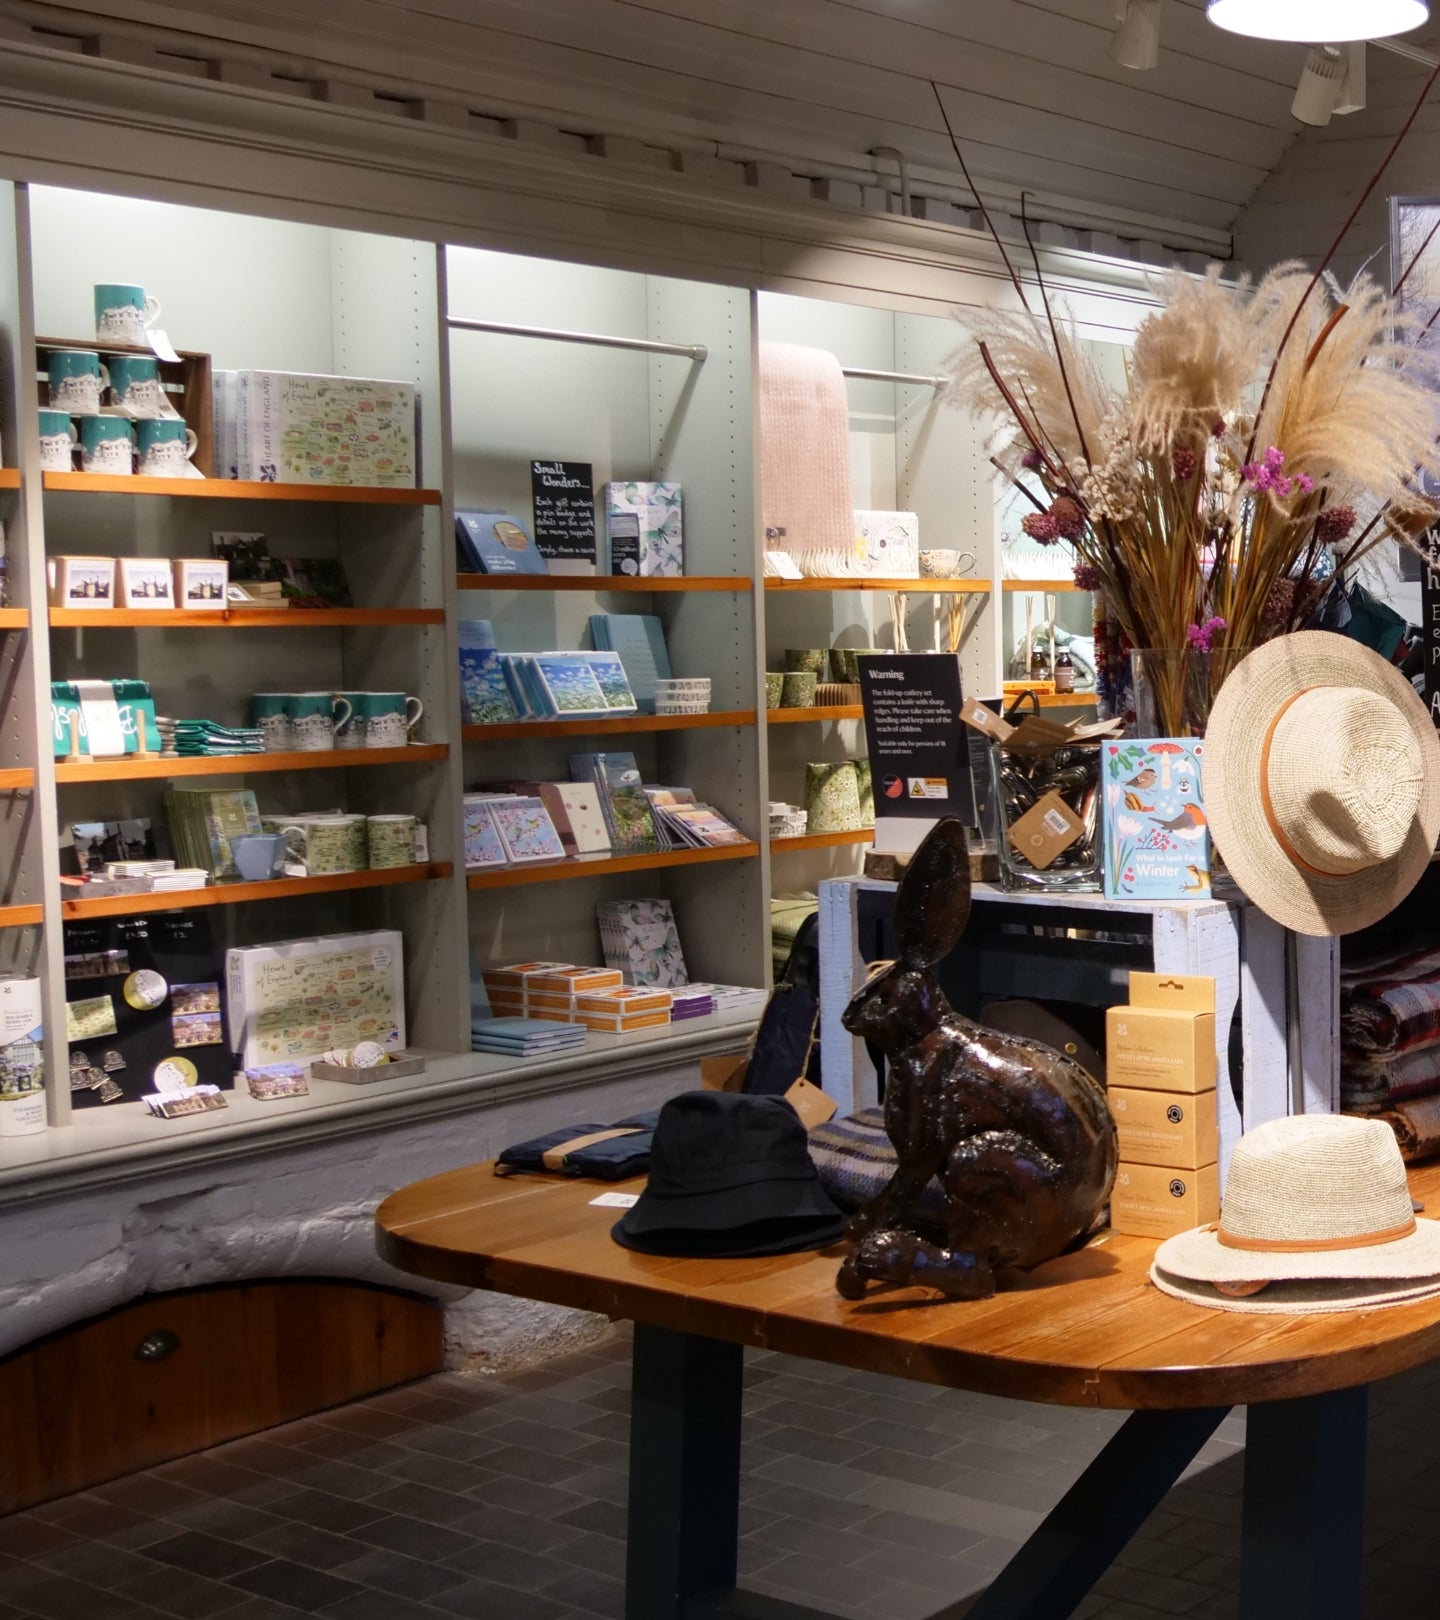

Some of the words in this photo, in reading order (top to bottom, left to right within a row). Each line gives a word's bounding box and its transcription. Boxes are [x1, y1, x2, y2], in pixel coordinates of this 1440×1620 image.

[262, 376, 271, 419] ENGLAND
[534, 462, 566, 475] Small
[536, 496, 553, 507] Each
[556, 497, 569, 511] gift
[571, 499, 593, 507] contains
[868, 669, 905, 681] Warning
[883, 689, 903, 697] fold-up
[904, 689, 922, 697] cutlery
[929, 699, 944, 707] sharp
[911, 717, 924, 725] keep
[1136, 854, 1155, 862] What
[1136, 863, 1180, 877] Winter
